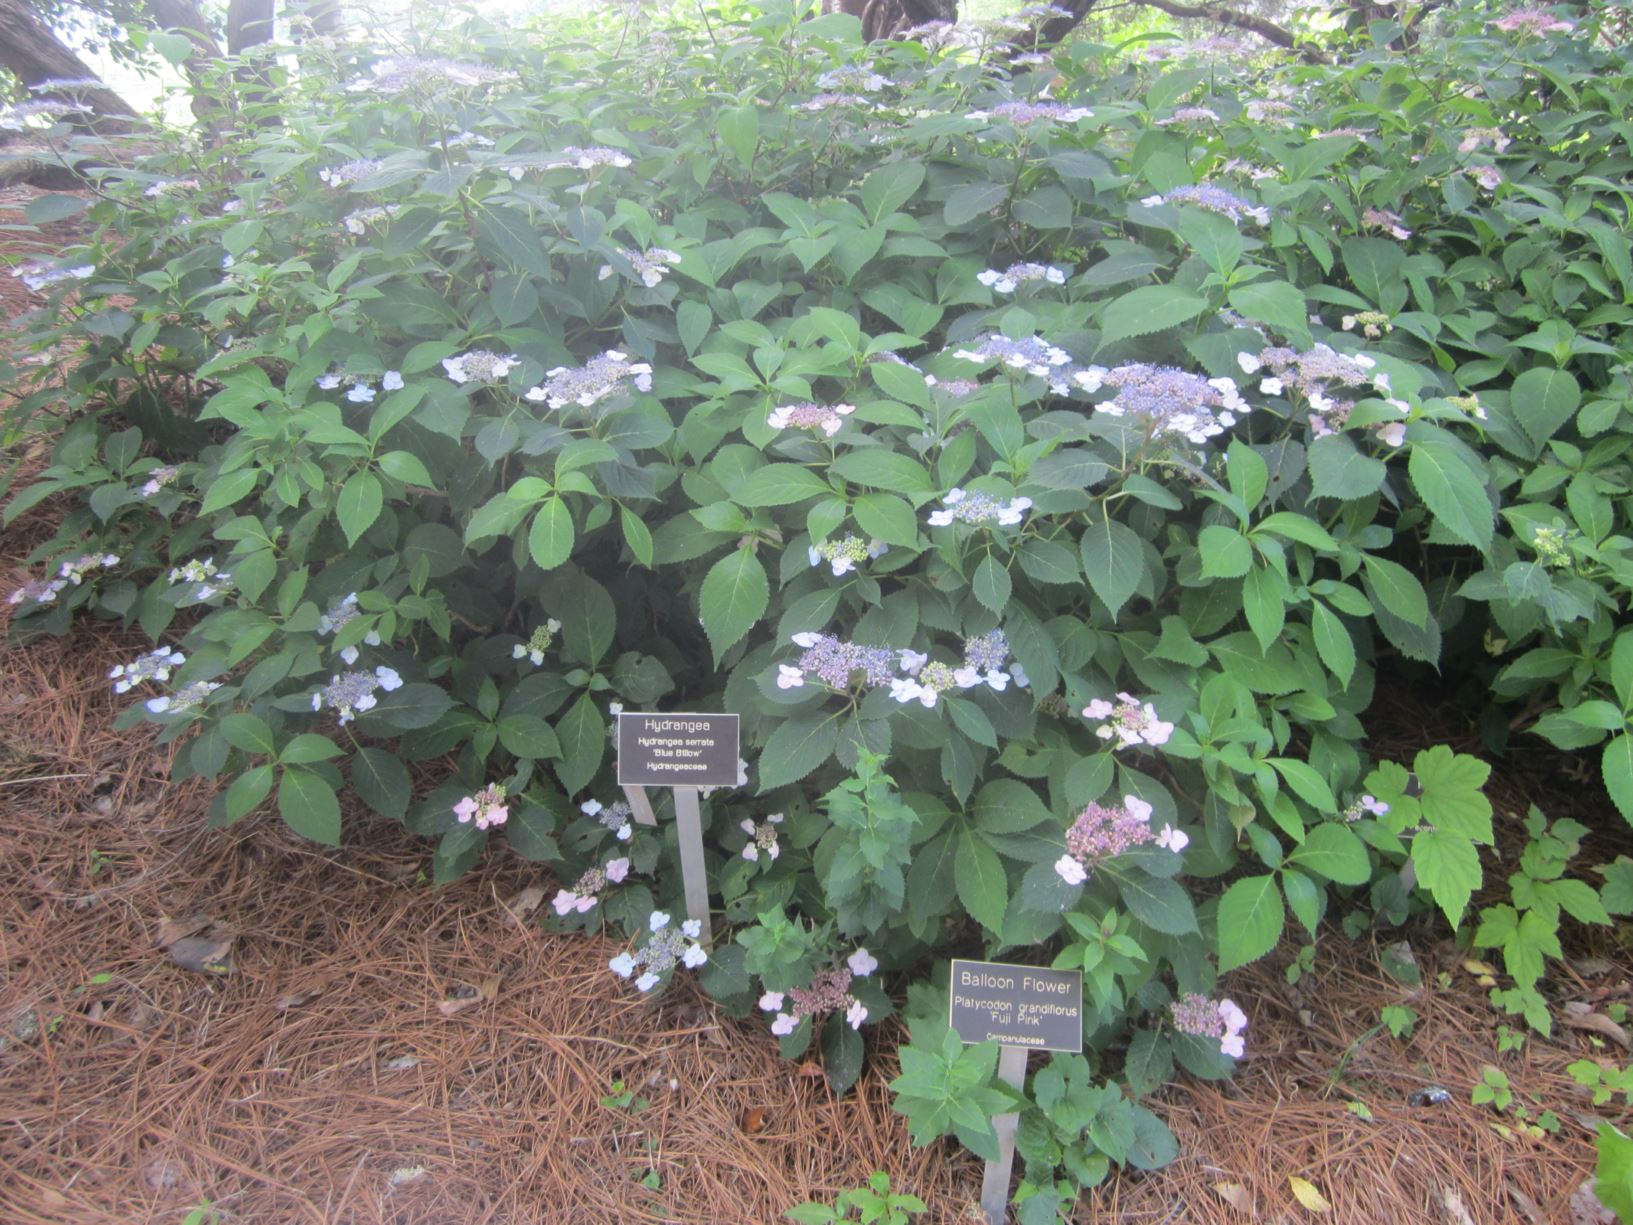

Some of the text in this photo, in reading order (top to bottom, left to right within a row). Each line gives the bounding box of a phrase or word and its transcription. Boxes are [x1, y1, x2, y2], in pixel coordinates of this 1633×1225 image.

[645, 719, 711, 733] Hydrangea
[638, 737, 714, 747] Hydrangea serrata
[647, 762, 708, 771] Hydrangeaceae
[961, 971, 1071, 994] Balloon Flower
[955, 995, 1078, 1017] Platycodon grandiflorus
